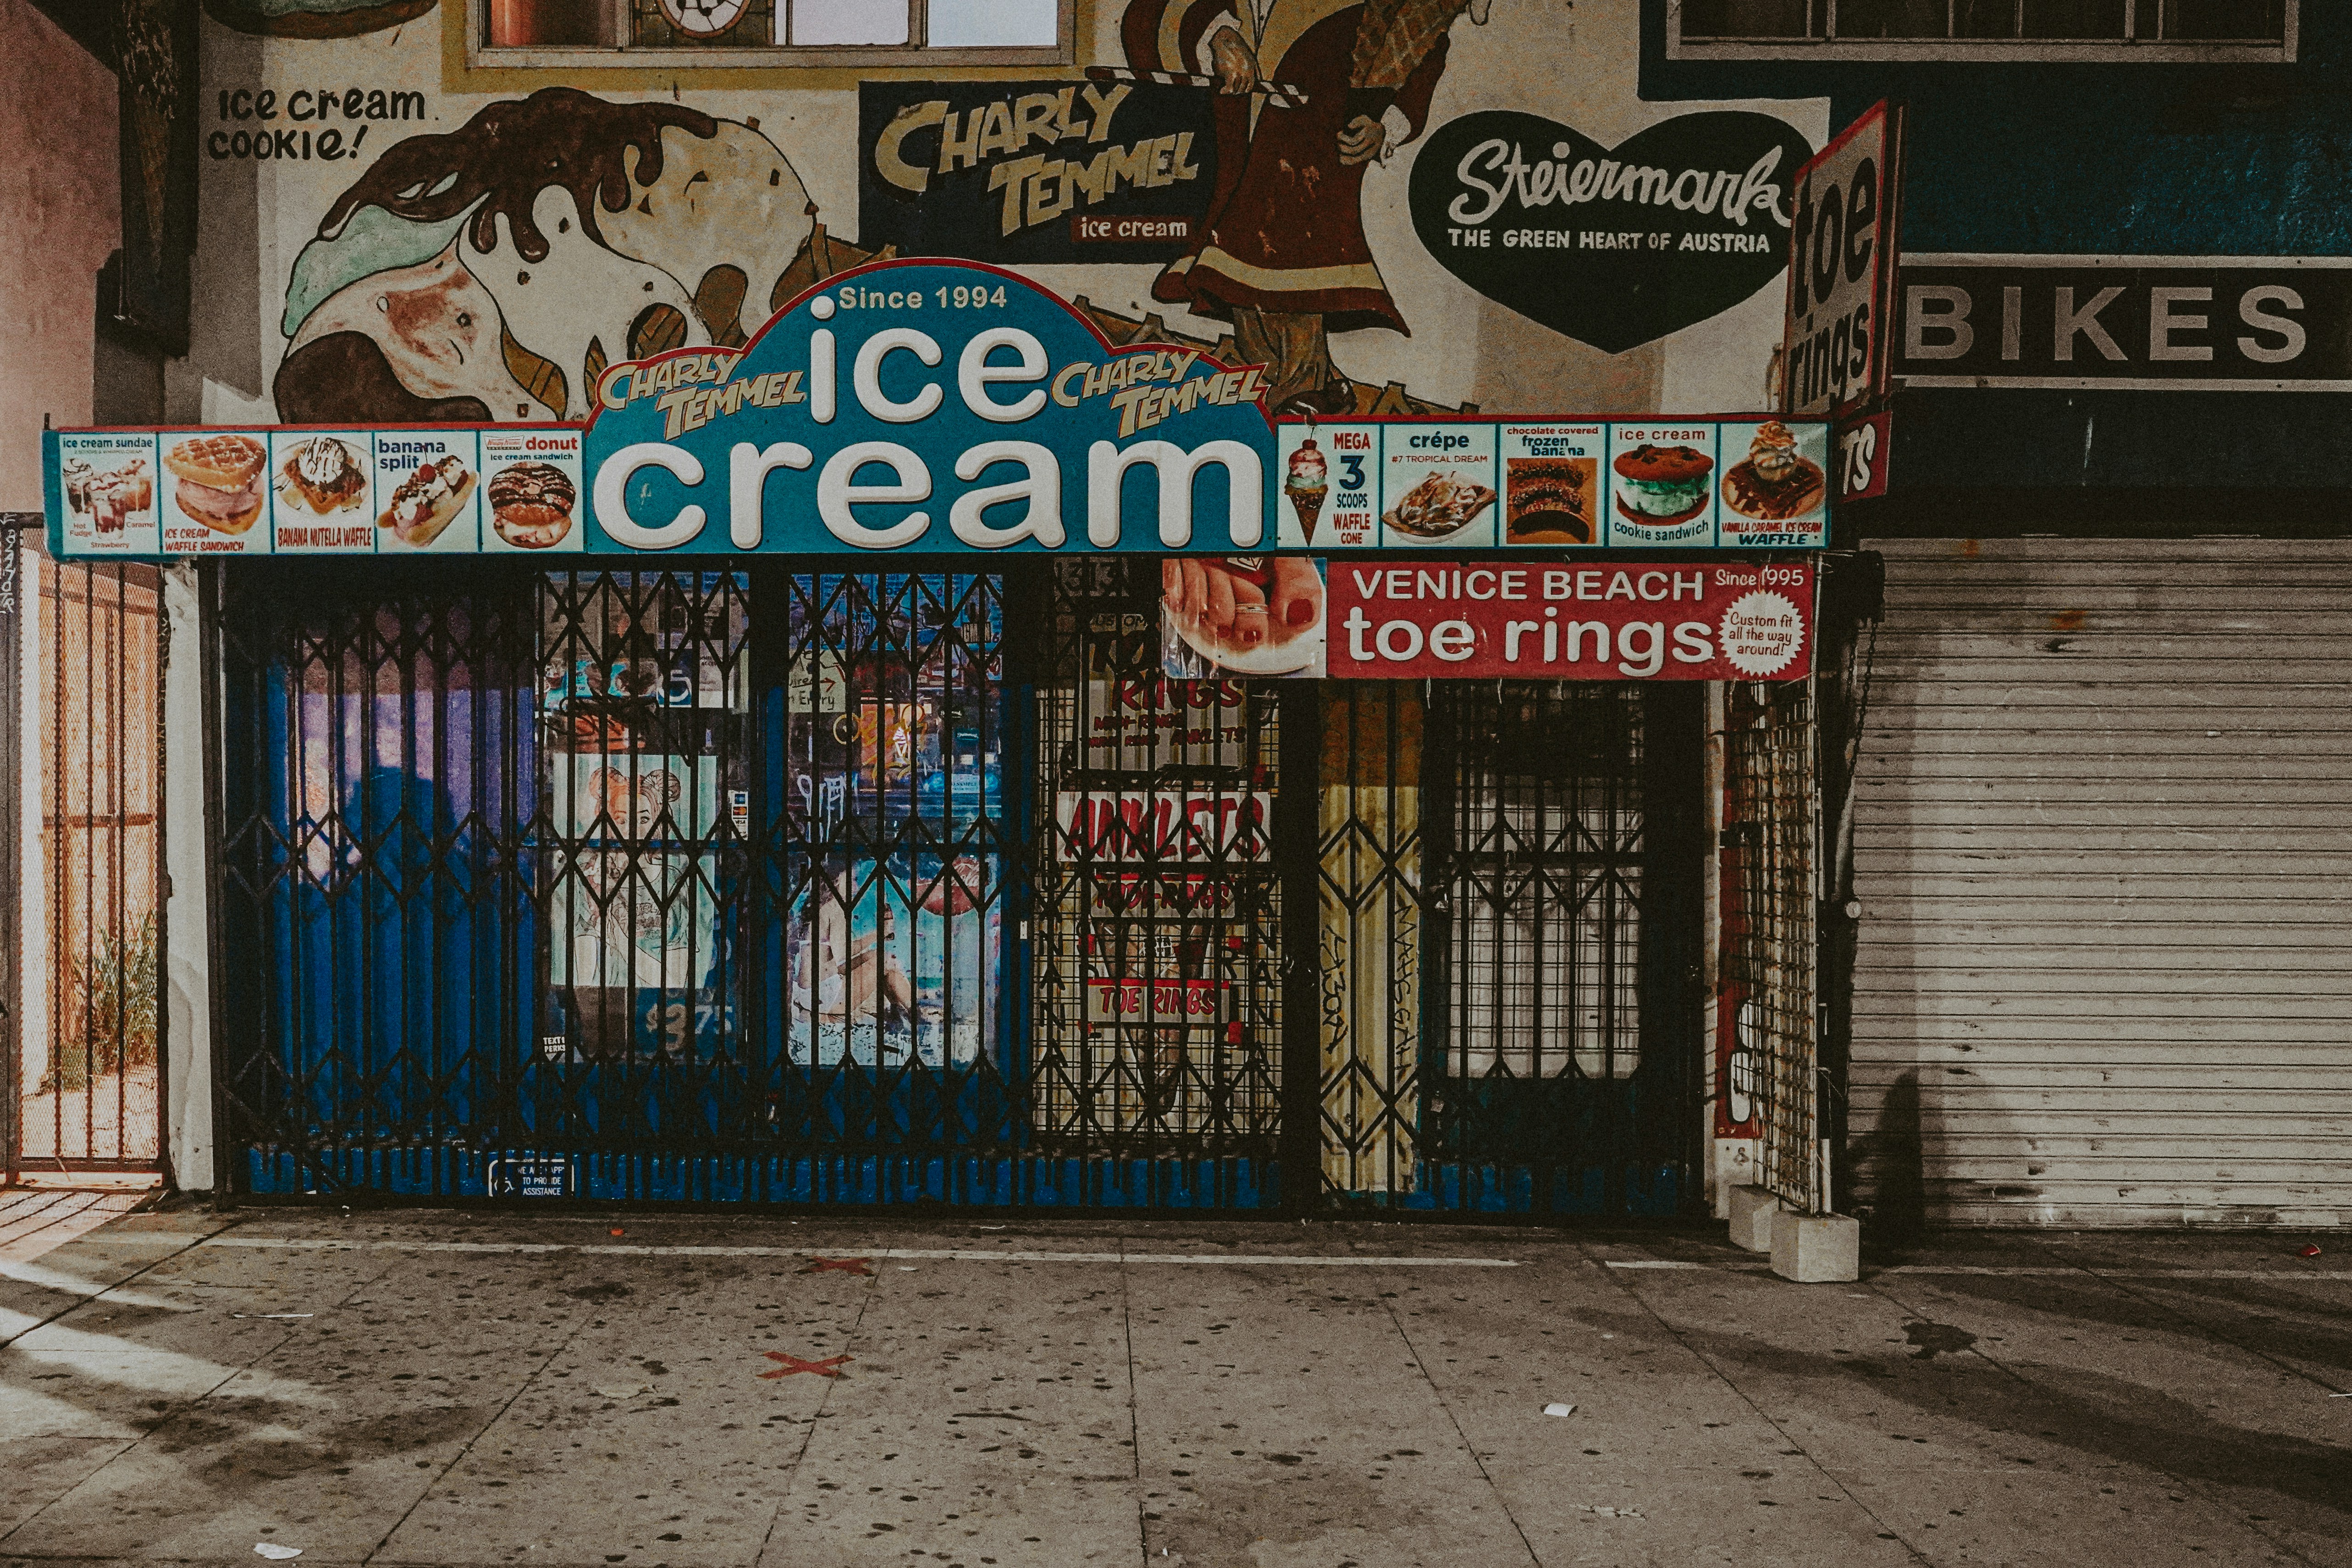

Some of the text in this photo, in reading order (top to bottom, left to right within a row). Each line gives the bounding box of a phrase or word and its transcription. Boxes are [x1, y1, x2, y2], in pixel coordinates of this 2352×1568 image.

[287, 88, 425, 120] cream
[875, 84, 1133, 192] CHARLY
[987, 132, 1198, 236] TEMMEL
[1448, 138, 1792, 227] Steiermark
[1081, 217, 1187, 237] ice cream
[1448, 229, 1770, 253] THE GREEN HEART OF AUSTRIA
[1794, 157, 1877, 320] toe
[839, 286, 1007, 309] Since 1994
[1905, 285, 2307, 363] BIKES
[811, 296, 1049, 423] ice
[1788, 303, 1870, 414] rings
[598, 353, 745, 409] CHARLY
[1050, 350, 1200, 408] CHARLY
[655, 371, 807, 441] TEMMEL
[1110, 368, 1265, 438] TEMMEL
[63, 437, 152, 448] ice cream sundae
[526, 436, 578, 450] donut
[1334, 433, 1370, 449] MEGA
[1522, 436, 1568, 447] frozen
[1619, 428, 1705, 440] ice cream
[379, 439, 445, 453] banana
[1531, 445, 1585, 457] banana
[380, 455, 419, 472] split
[1339, 455, 1365, 490] 3
[594, 440, 1263, 549] cream
[1337, 493, 1367, 508] SCOOPS
[1333, 513, 1370, 530] WAFFLE
[1614, 521, 1709, 541] cookie sandwich
[1722, 522, 1822, 533] VANILLA CARAMEL ICE CREAM
[165, 528, 209, 538] ICE CREAM
[278, 527, 371, 547] BANANA NUTELLA WAFFLE
[1341, 533, 1362, 544] CONE
[1739, 534, 1806, 545] WAFFLE
[166, 541, 244, 552] WAFFLE SANDWICH
[1353, 569, 1703, 601] VENICE BEACH
[1716, 569, 1804, 586] Since 1995
[1731, 612, 1793, 627] Custom fit
[1343, 607, 1714, 677] toe rings
[1729, 627, 1792, 646] all the way
[1737, 643, 1784, 656] around!
[1100, 987, 1215, 1015] TOE RINGS
